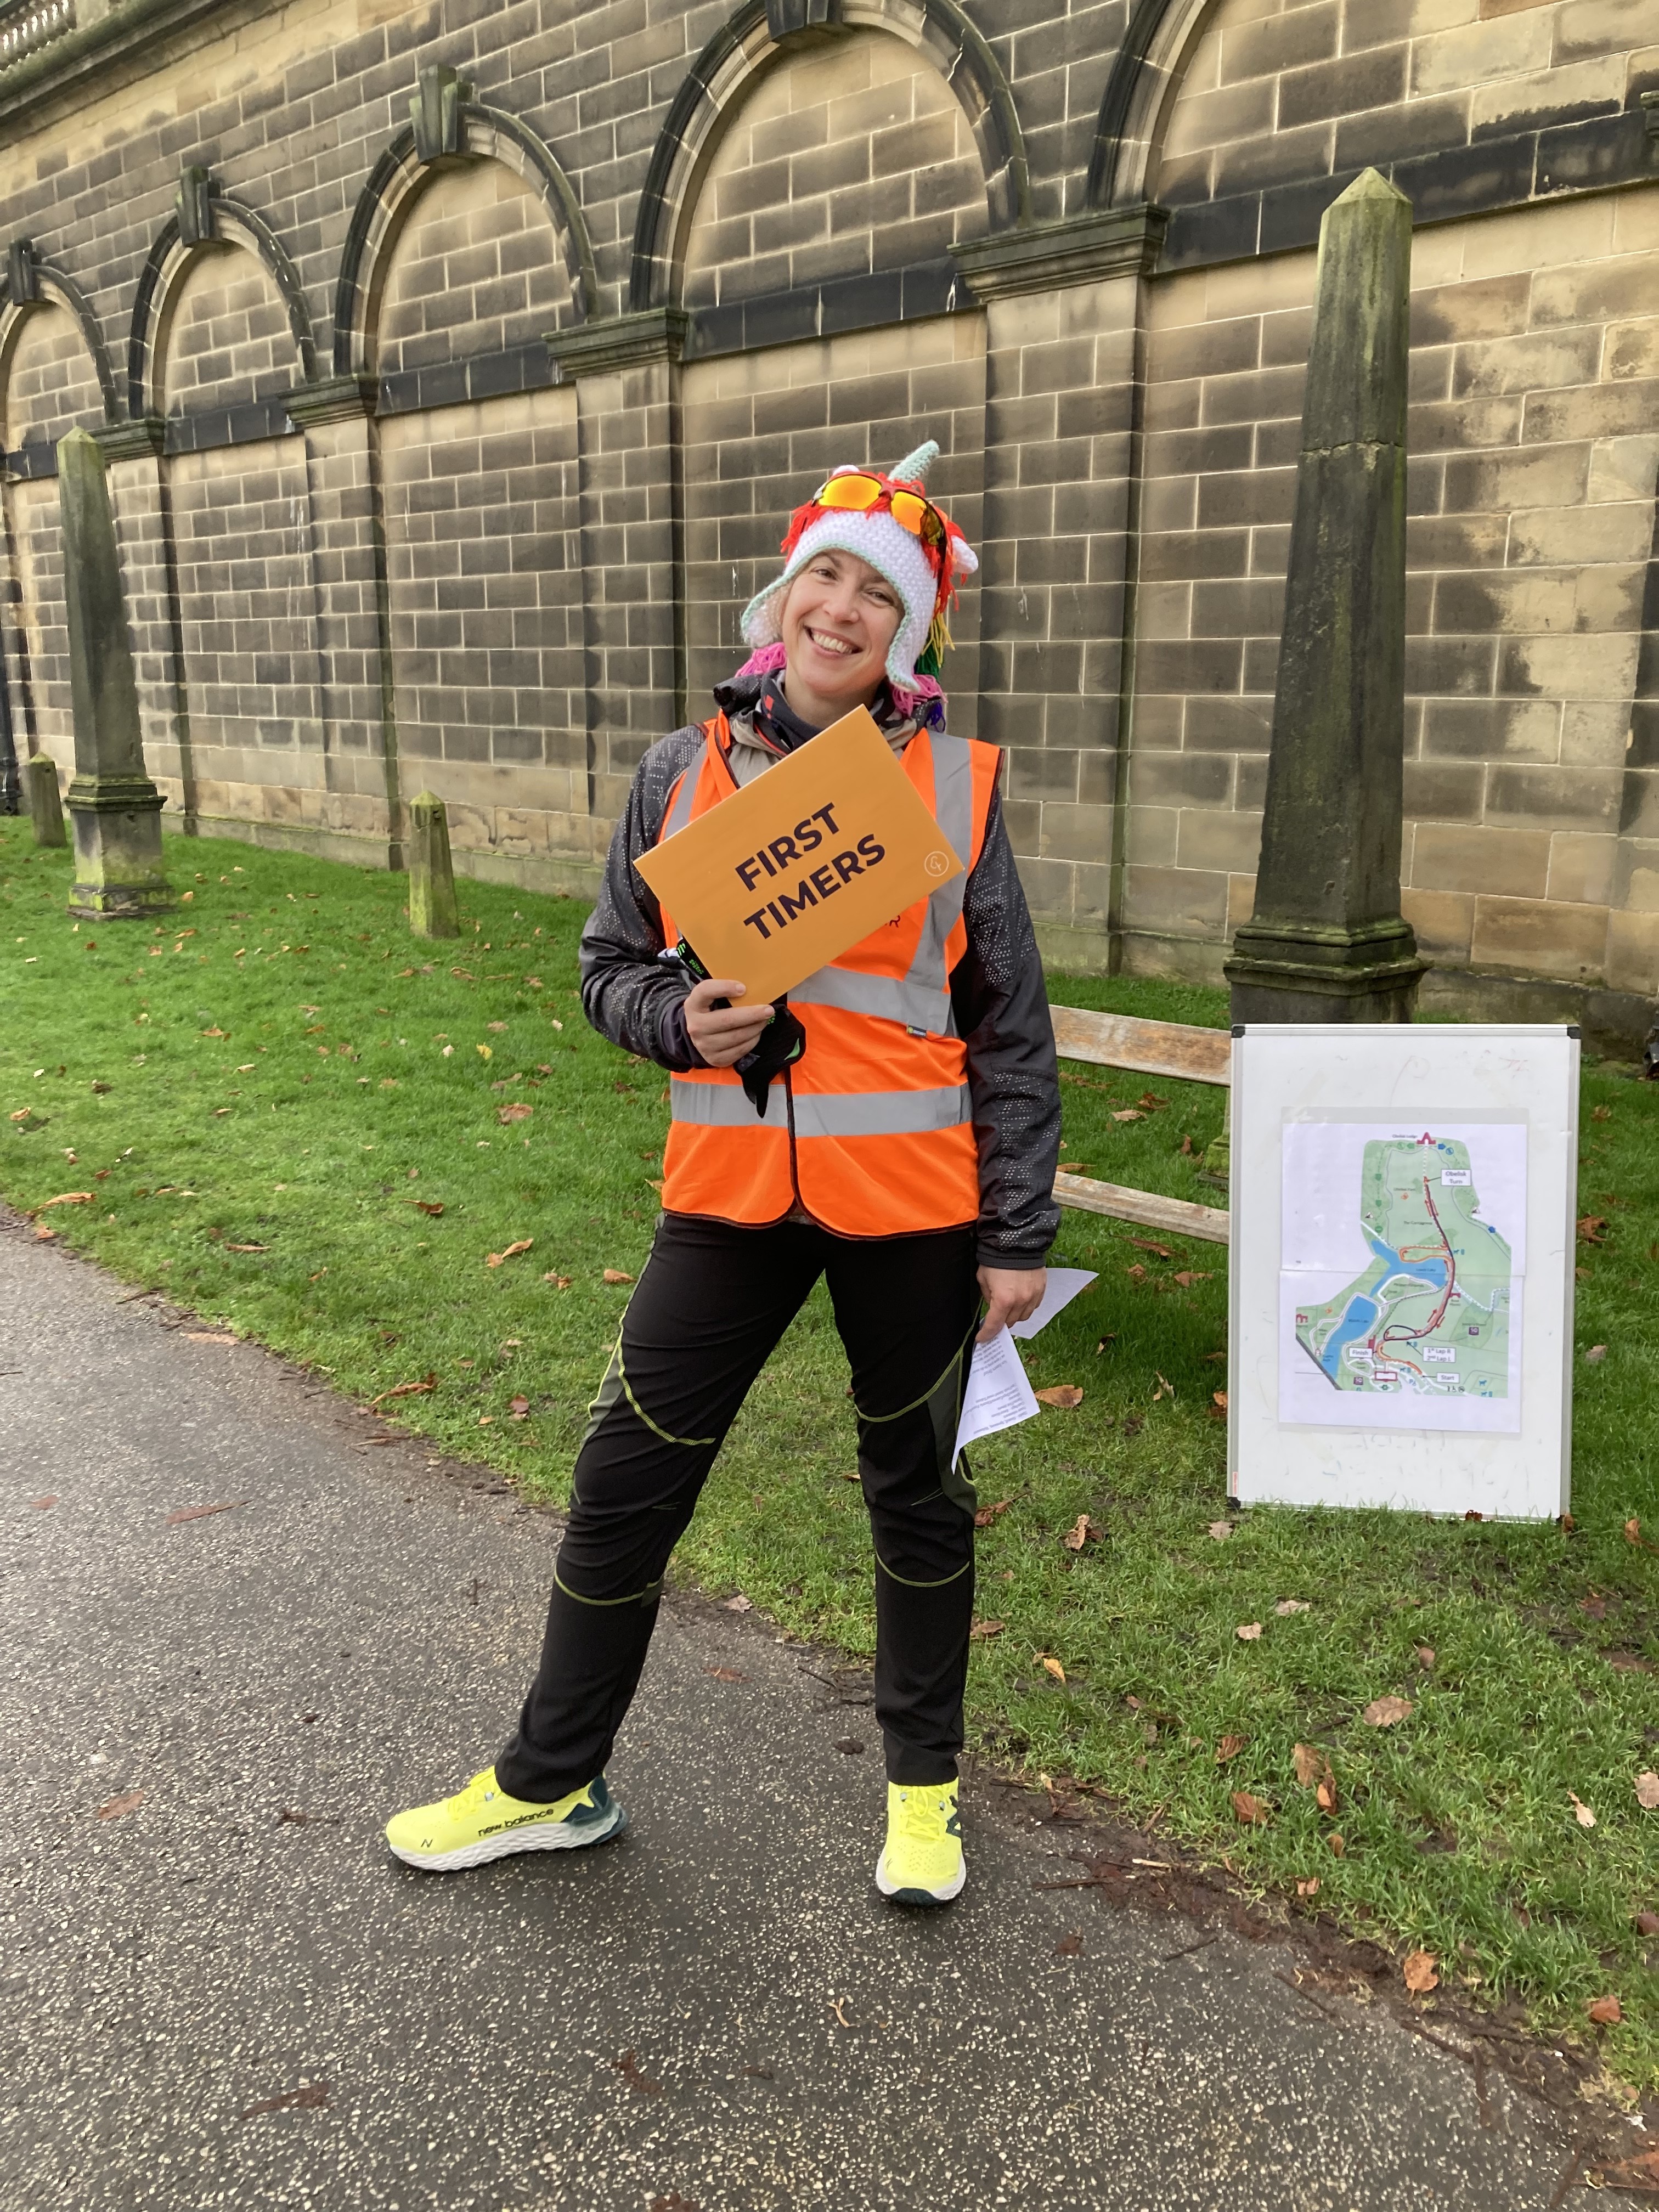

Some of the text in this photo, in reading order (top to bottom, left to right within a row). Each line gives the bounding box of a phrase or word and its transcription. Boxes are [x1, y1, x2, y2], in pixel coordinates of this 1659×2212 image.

[735, 802, 839, 892] FIRST
[743, 833, 885, 939] TIMERS
[478, 1809, 554, 1836] new balance
